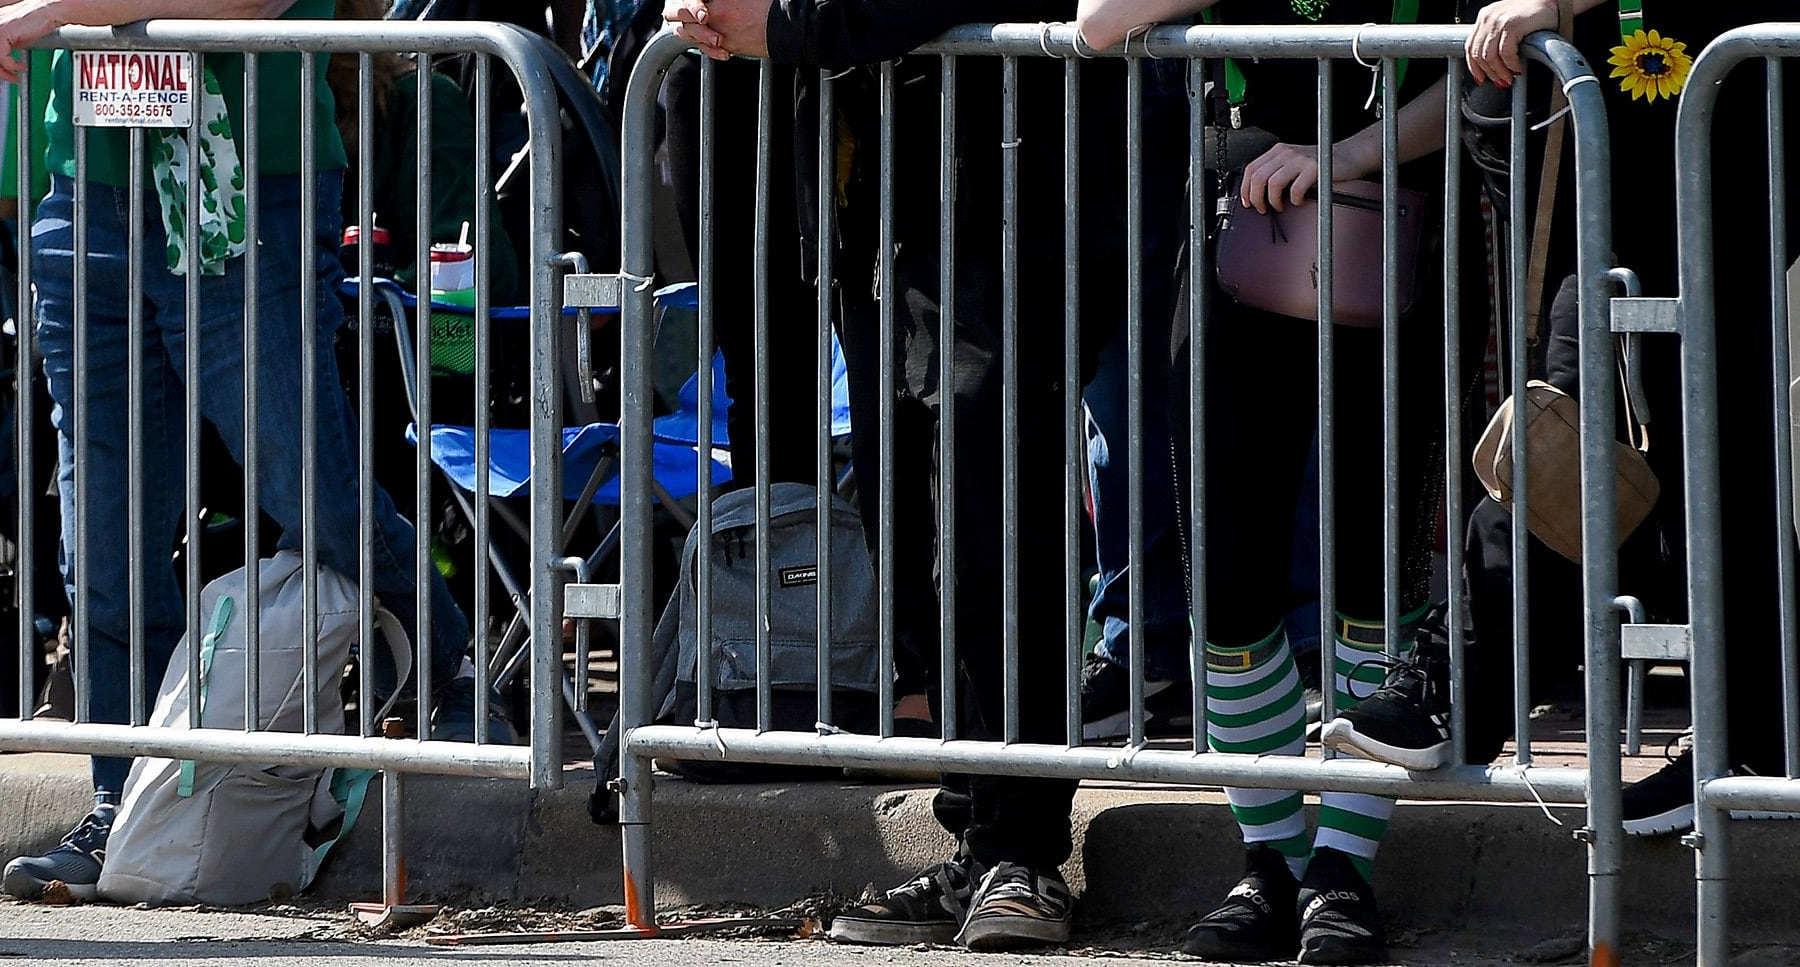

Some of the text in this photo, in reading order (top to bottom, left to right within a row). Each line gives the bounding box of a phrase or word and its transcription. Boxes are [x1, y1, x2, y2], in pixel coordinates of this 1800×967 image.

[80, 54, 187, 91] NATIONAL
[80, 92, 188, 103] RENT-A-FENCE
[95, 104, 172, 117] 800-352-5675
[1302, 889, 1360, 920] adidas
